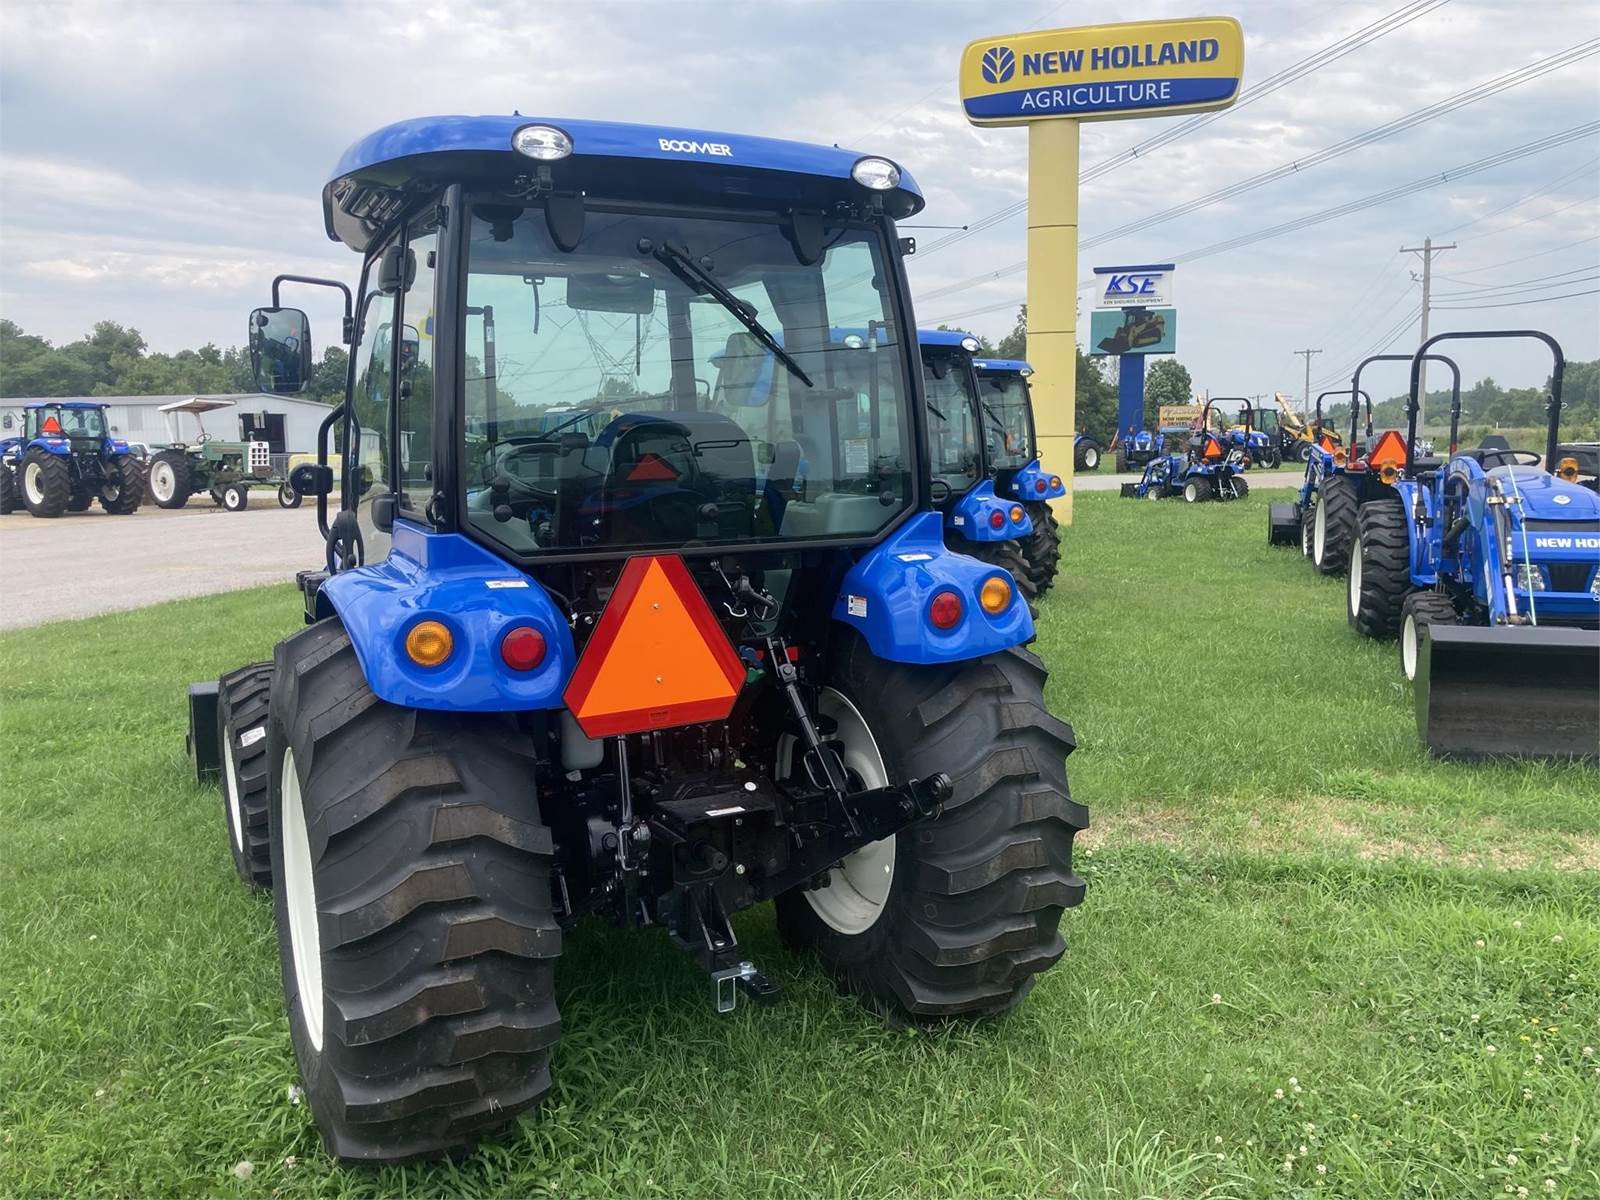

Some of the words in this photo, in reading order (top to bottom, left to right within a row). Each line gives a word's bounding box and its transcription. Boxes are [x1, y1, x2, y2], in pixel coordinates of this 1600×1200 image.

[1023, 49, 1084, 76] NEW
[1091, 38, 1219, 70] HOLLAND
[1021, 81, 1171, 110] AGRICULTURE
[658, 138, 733, 156] BOOMER
[1104, 274, 1162, 295] KSE
[1536, 538, 1572, 548] NEW
